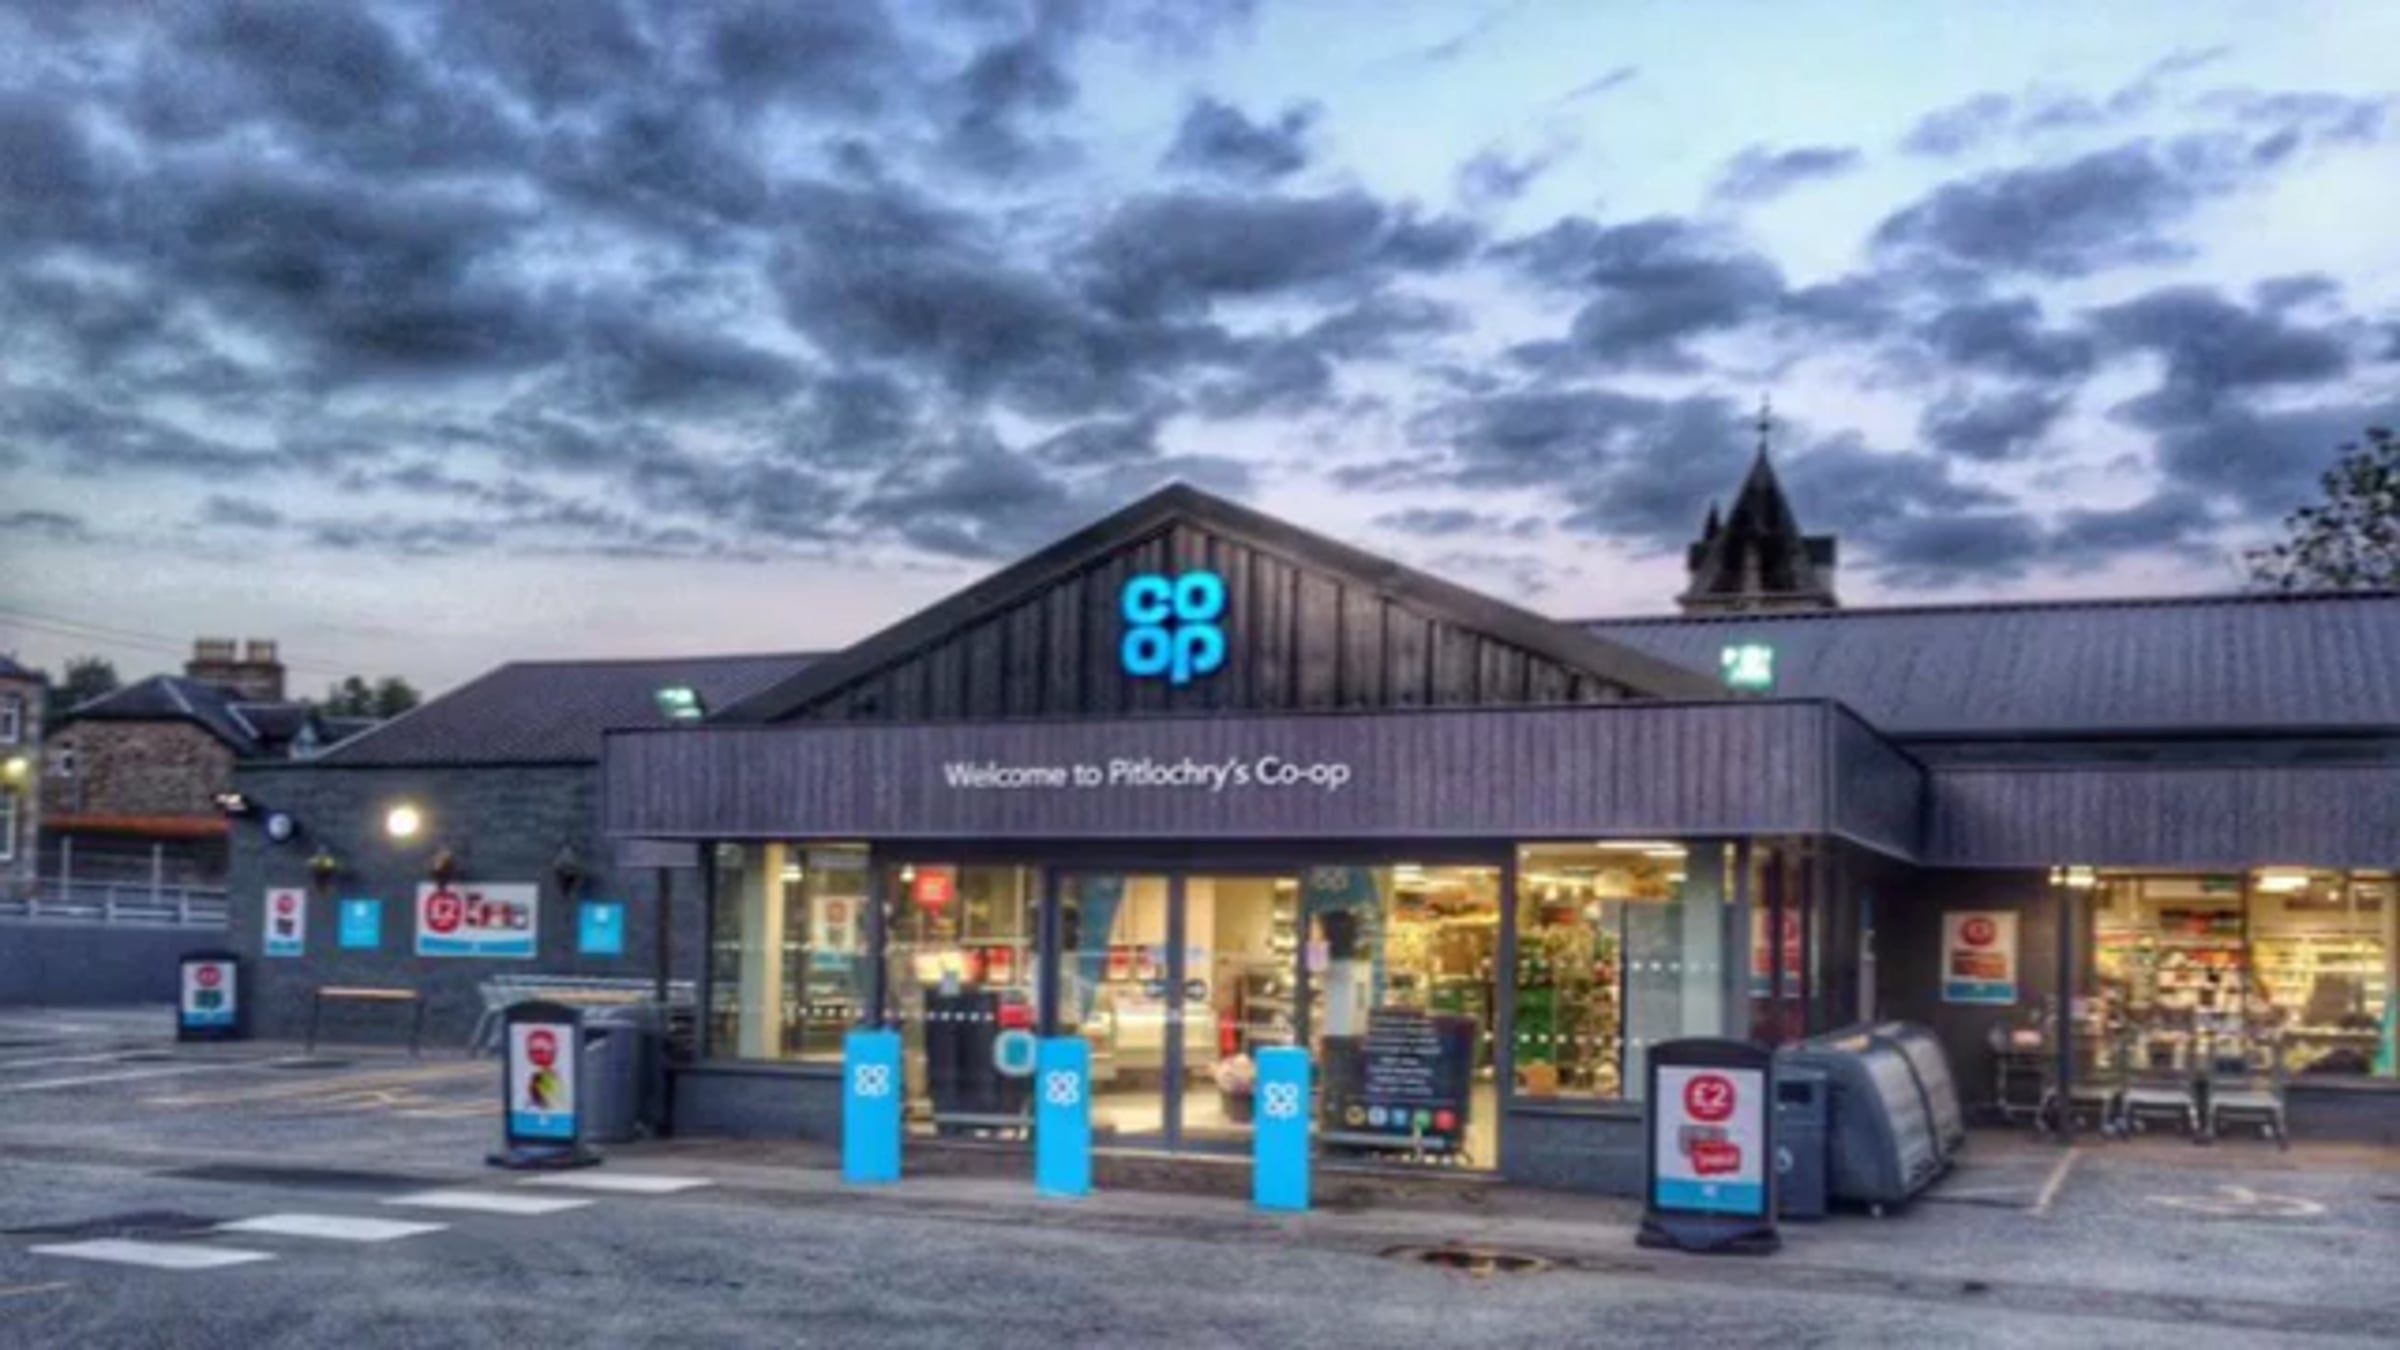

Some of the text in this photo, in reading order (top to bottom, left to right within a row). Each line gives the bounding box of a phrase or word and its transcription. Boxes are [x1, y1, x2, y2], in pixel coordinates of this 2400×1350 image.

[943, 755, 1351, 792] Welcome to Pitlochry's Co-op
[1692, 1082, 1729, 1108] £2
